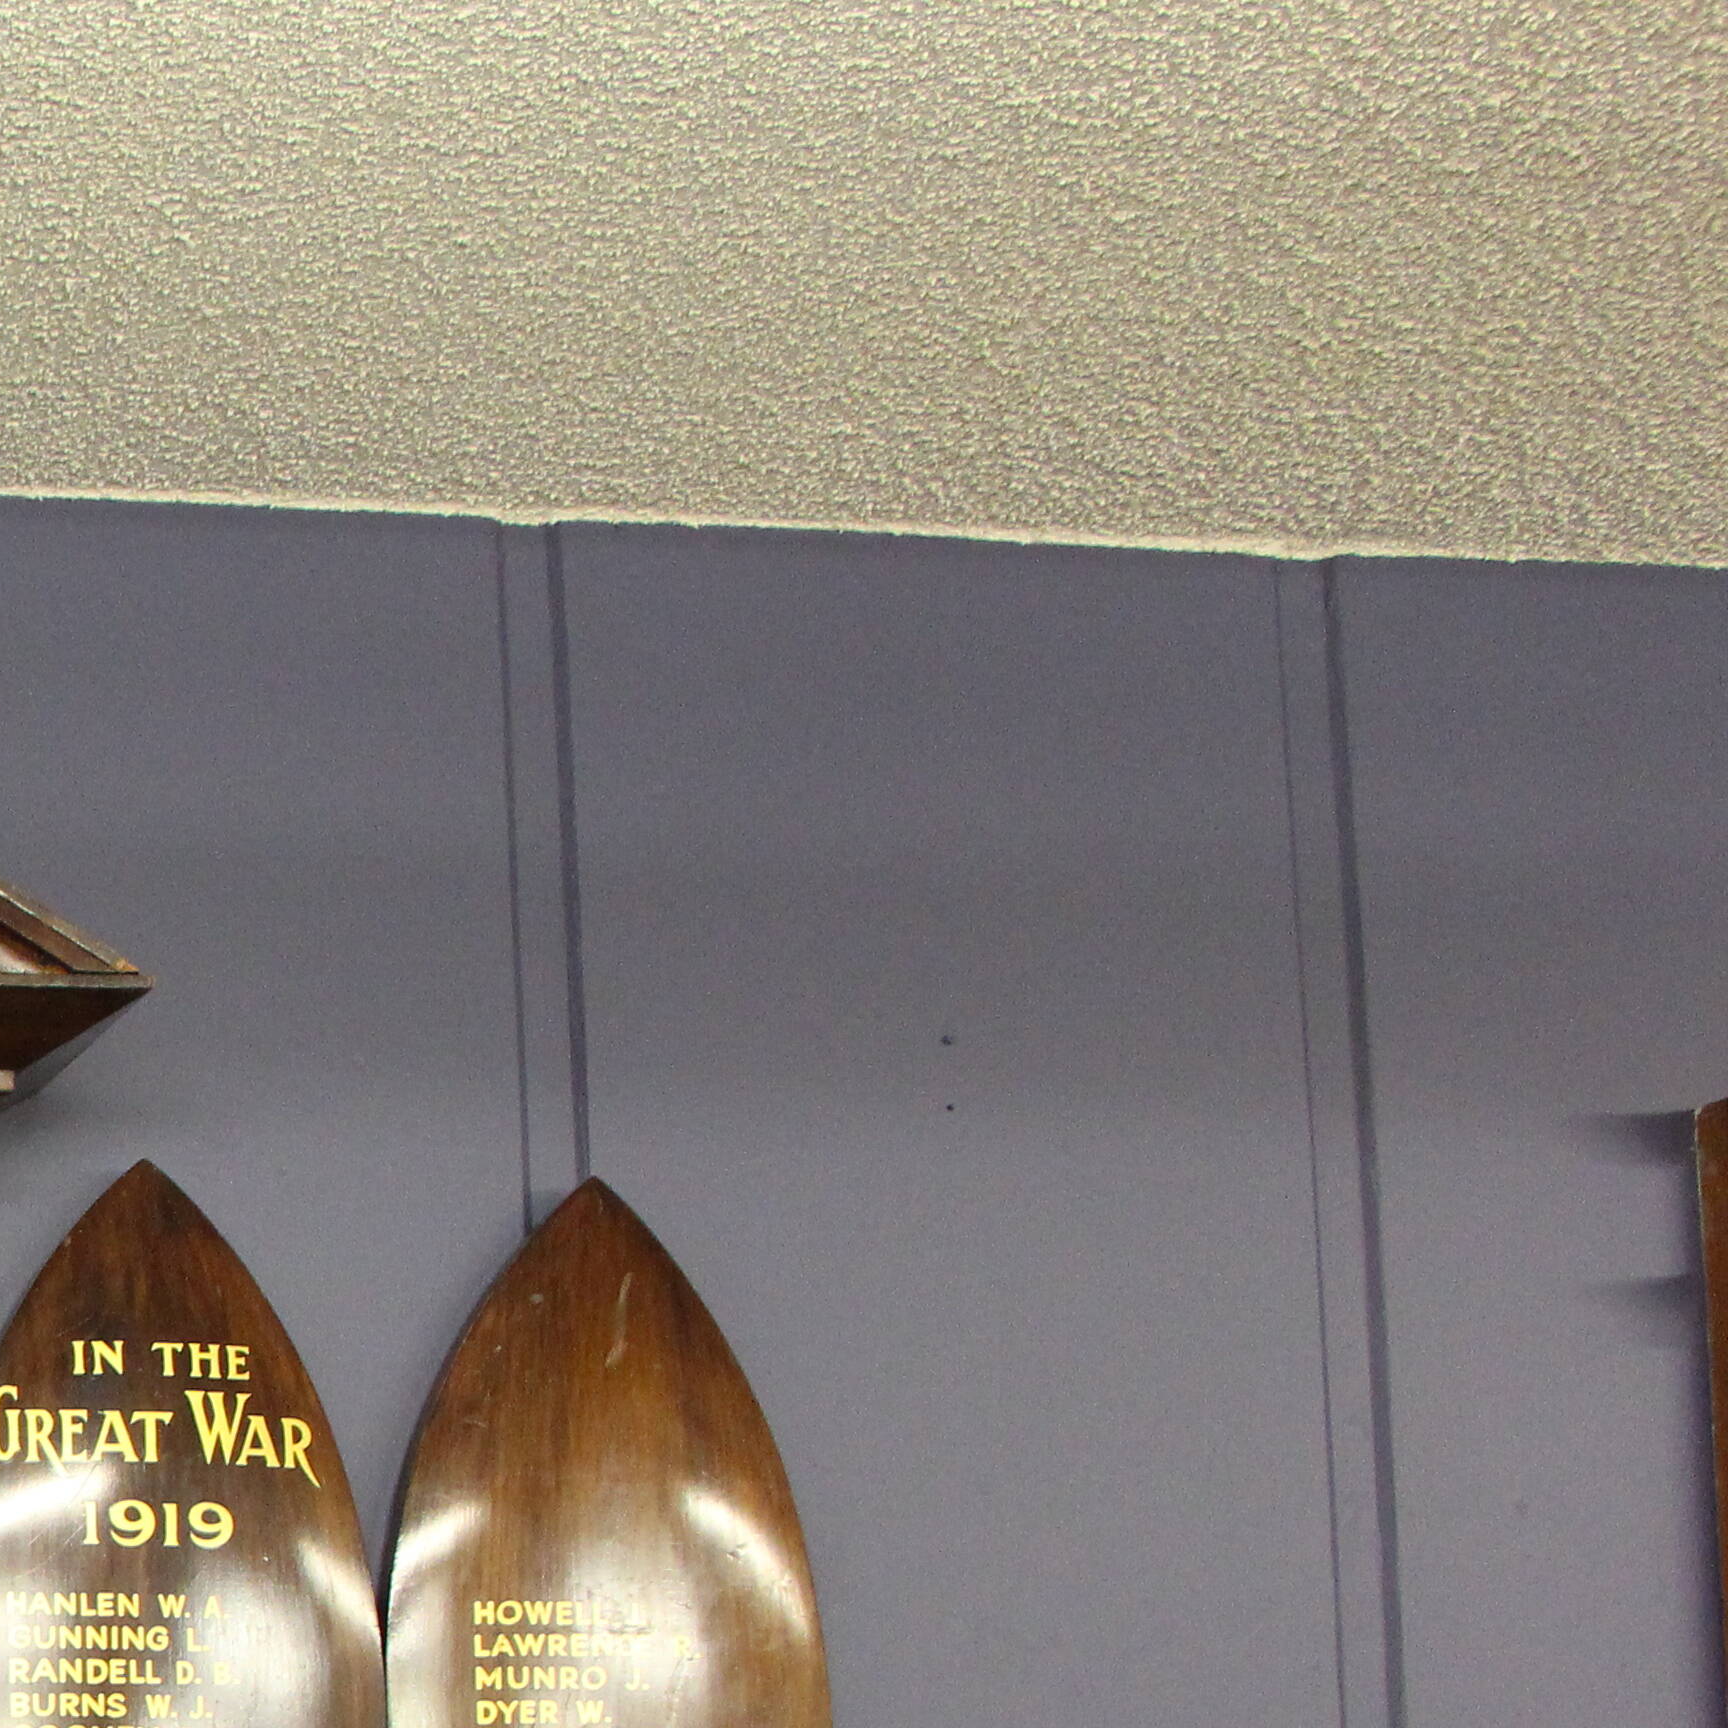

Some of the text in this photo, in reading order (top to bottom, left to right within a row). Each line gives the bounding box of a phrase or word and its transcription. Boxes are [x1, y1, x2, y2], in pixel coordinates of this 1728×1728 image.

[72, 1341, 250, 1380] IN THE
[185, 1390, 320, 1486] WAR
[84, 1500, 234, 1547] 1919
[475, 1666, 651, 1691] MUNRO J.
